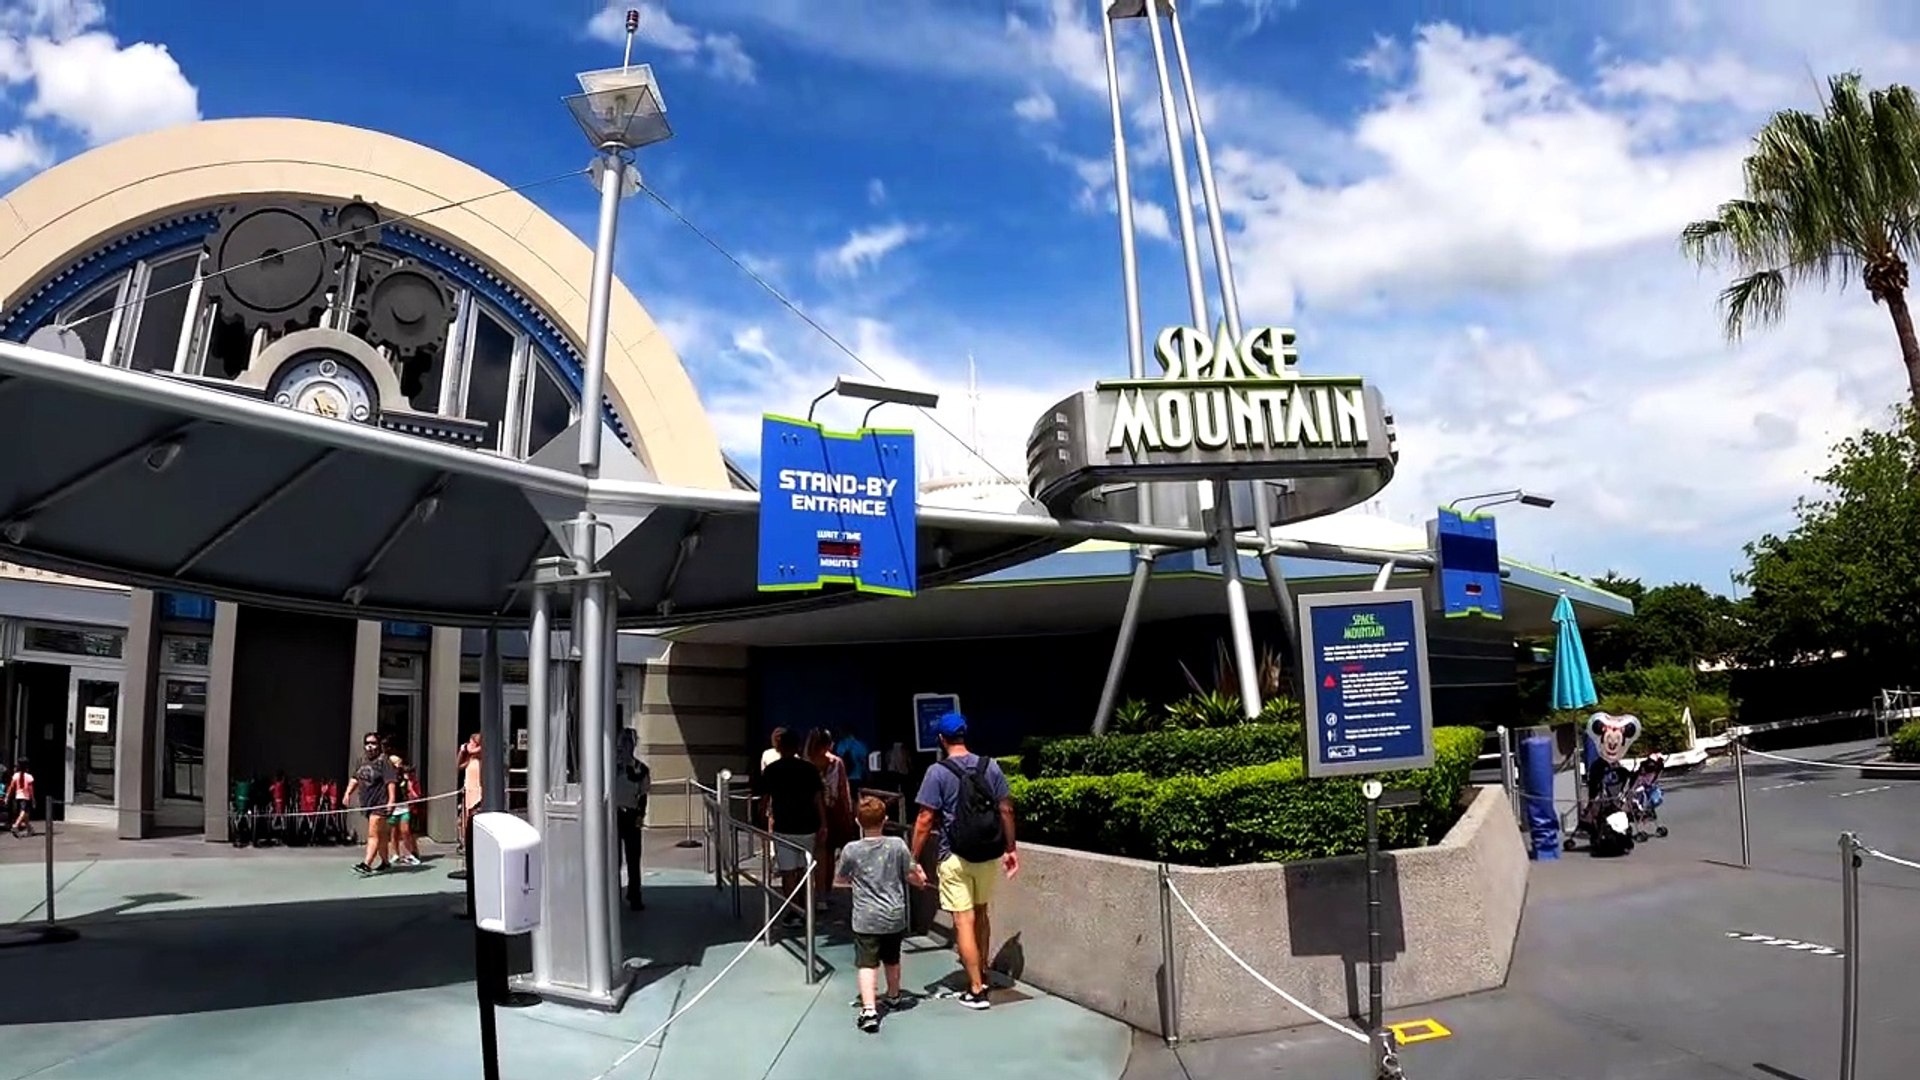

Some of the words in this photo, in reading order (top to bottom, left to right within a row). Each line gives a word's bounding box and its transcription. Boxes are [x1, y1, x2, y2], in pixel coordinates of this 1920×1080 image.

[1155, 322, 1298, 379] SPACE
[1107, 384, 1368, 456] MOUNTAIN
[779, 469, 898, 498] STAND-BY
[792, 494, 887, 516] ENTRANCE
[817, 530, 839, 539] WAIT
[842, 532, 861, 541] TIME
[820, 558, 858, 568] MINUTES
[1352, 613, 1377, 625] SPACE
[1343, 625, 1385, 639] MOUNTAIN
